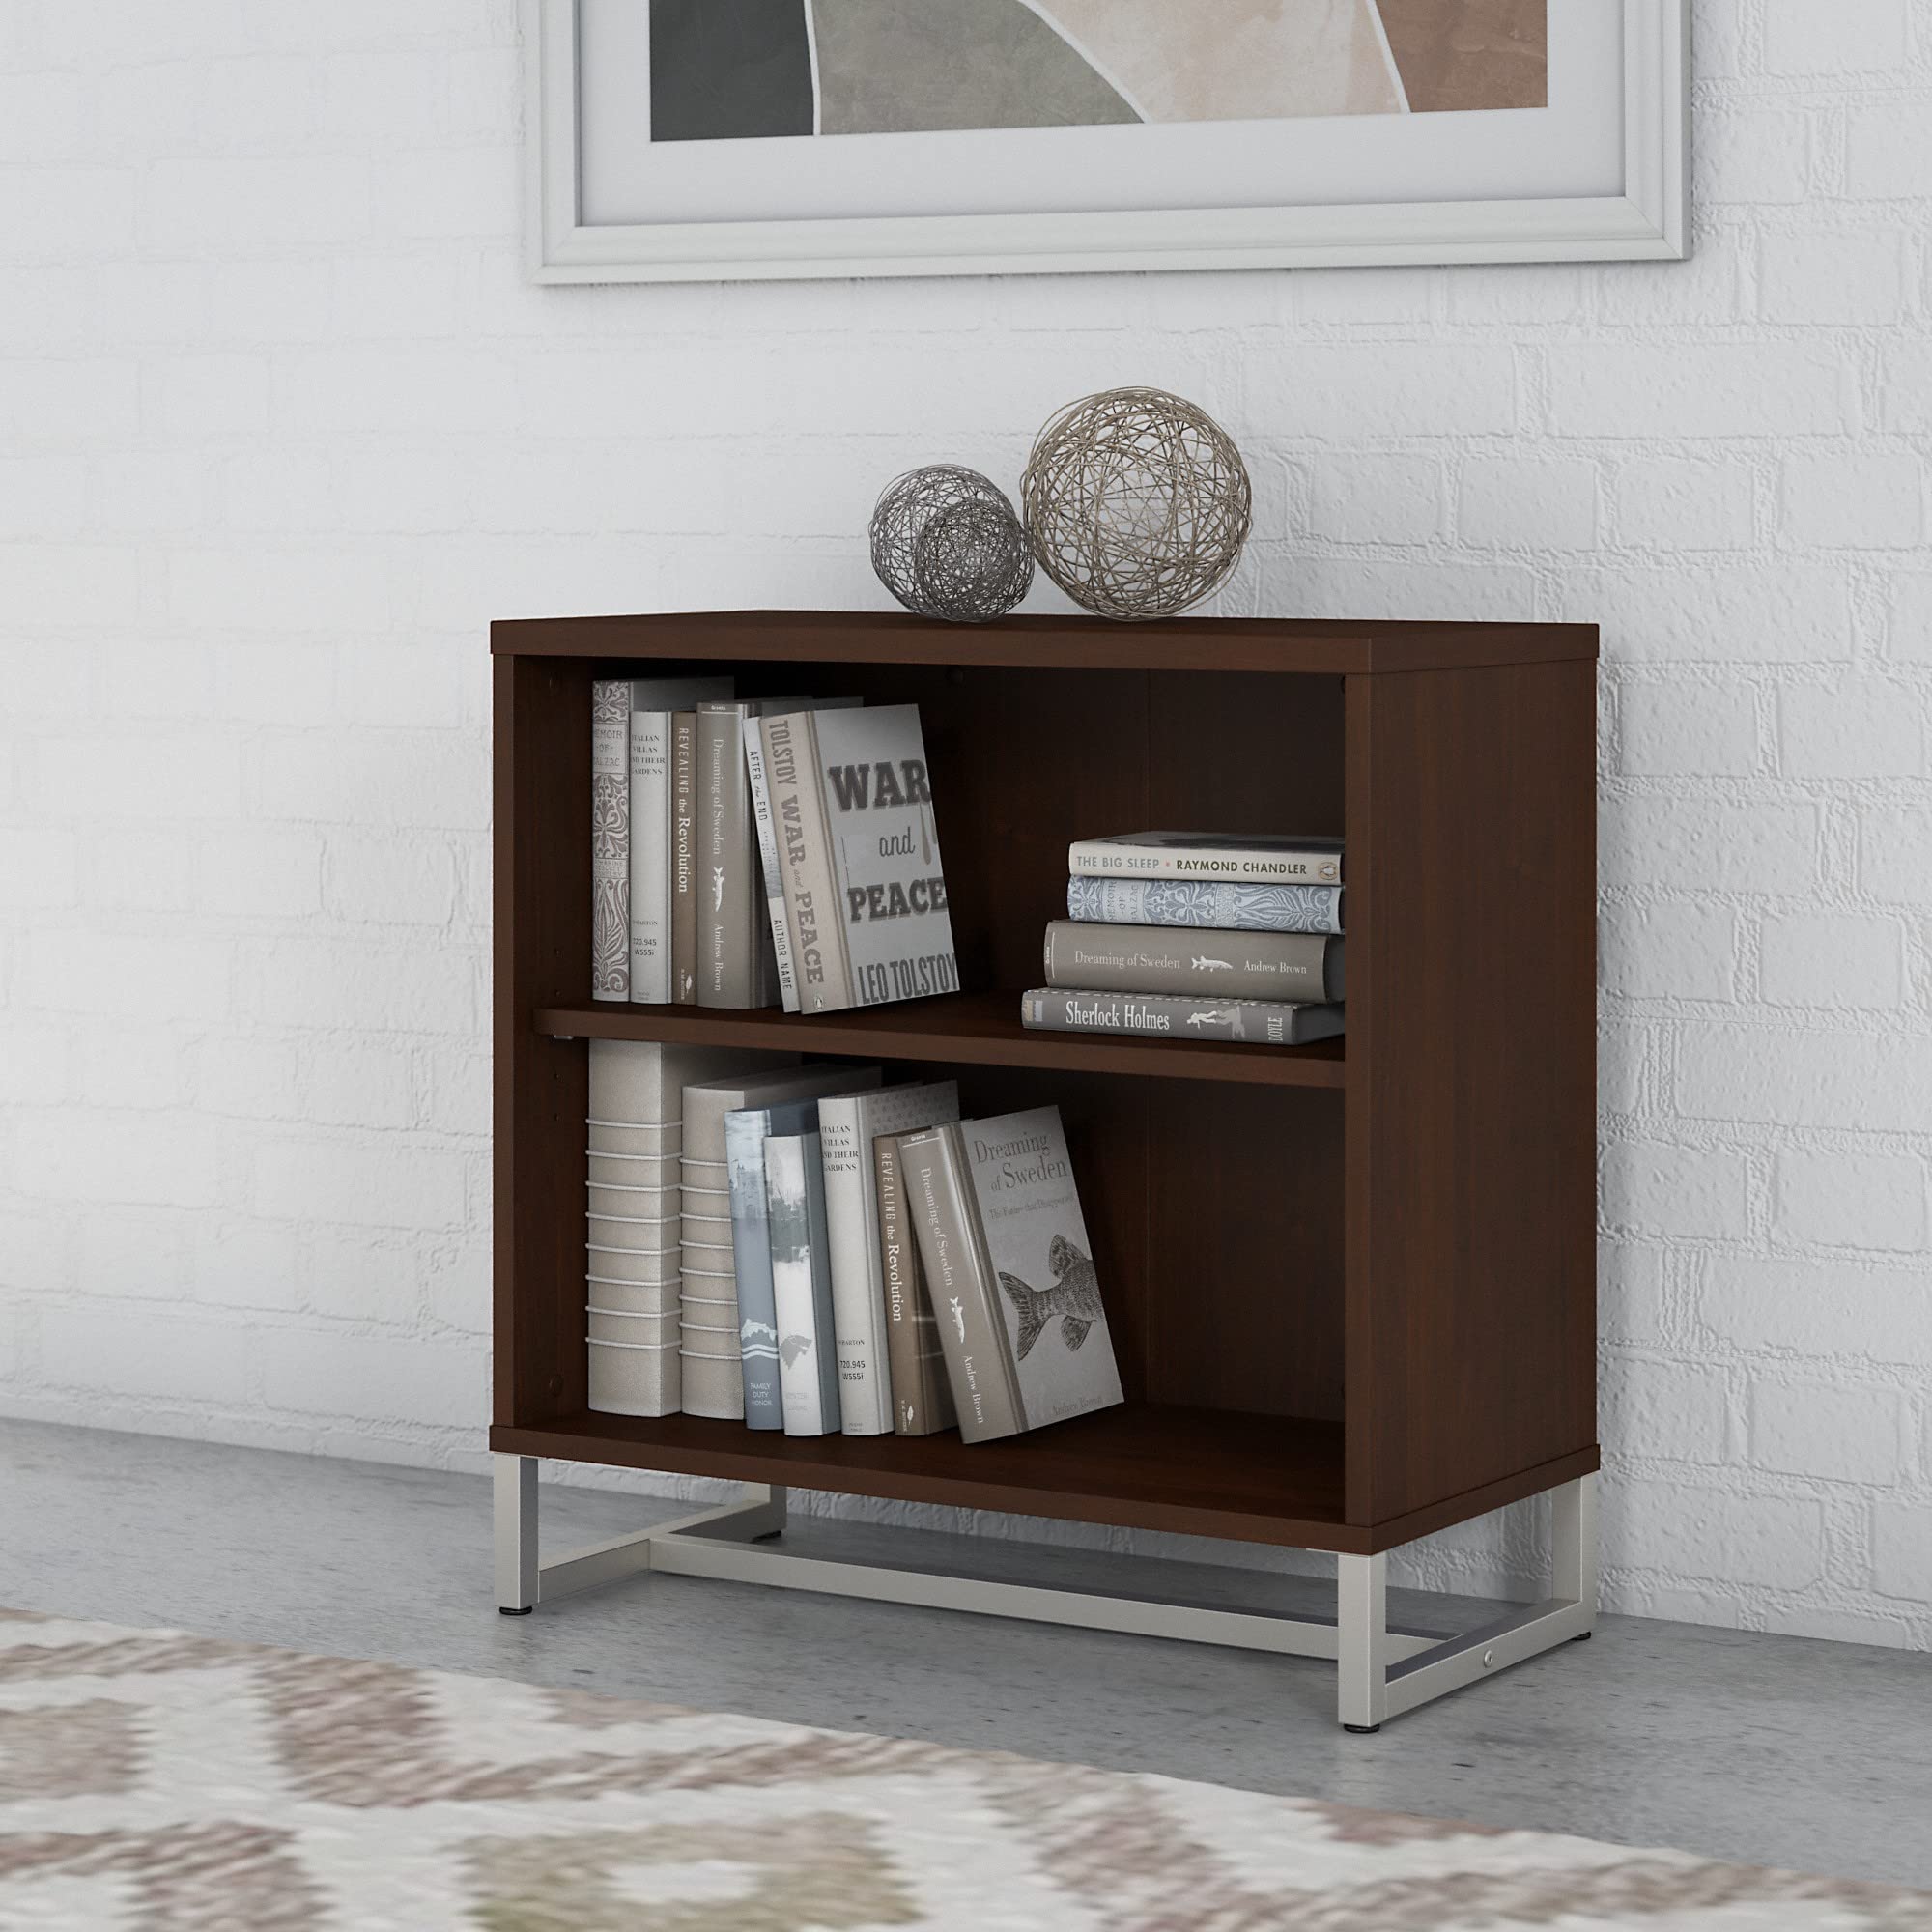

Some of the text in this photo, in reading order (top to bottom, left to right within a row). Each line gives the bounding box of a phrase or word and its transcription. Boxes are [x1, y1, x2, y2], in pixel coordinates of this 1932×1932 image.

[769, 720, 797, 785] TOLSTOY
[678, 727, 692, 893] REVEALING the Revolution
[750, 751, 762, 780] AFTER
[756, 801, 768, 821] END
[827, 759, 932, 812] WAR
[781, 794, 806, 867] WAR
[879, 827, 916, 857] and
[711, 739, 724, 991] Dreaming of Sweden Andrew Brown
[1076, 856, 1307, 874] THE BIG SLEEP RAYMOND CHANDLER
[847, 876, 949, 923] PEACE
[774, 920, 792, 989] AUTHOR NAME
[795, 891, 824, 984] PEACE
[1075, 950, 1307, 974] Dreaming of Sweden Andrew Brown
[858, 952, 959, 1005] LEO TOLSTOY
[1065, 1001, 1170, 1030] Sherlock Holmes
[1268, 1017, 1283, 1041] DOYLE
[974, 1132, 1051, 1163] Dreaming
[991, 1155, 1067, 1191] of Sweden
[881, 1152, 904, 1321] REVEALING the Revolution
[921, 1167, 983, 1424] Dreaming of Sweden Andrew Brown
